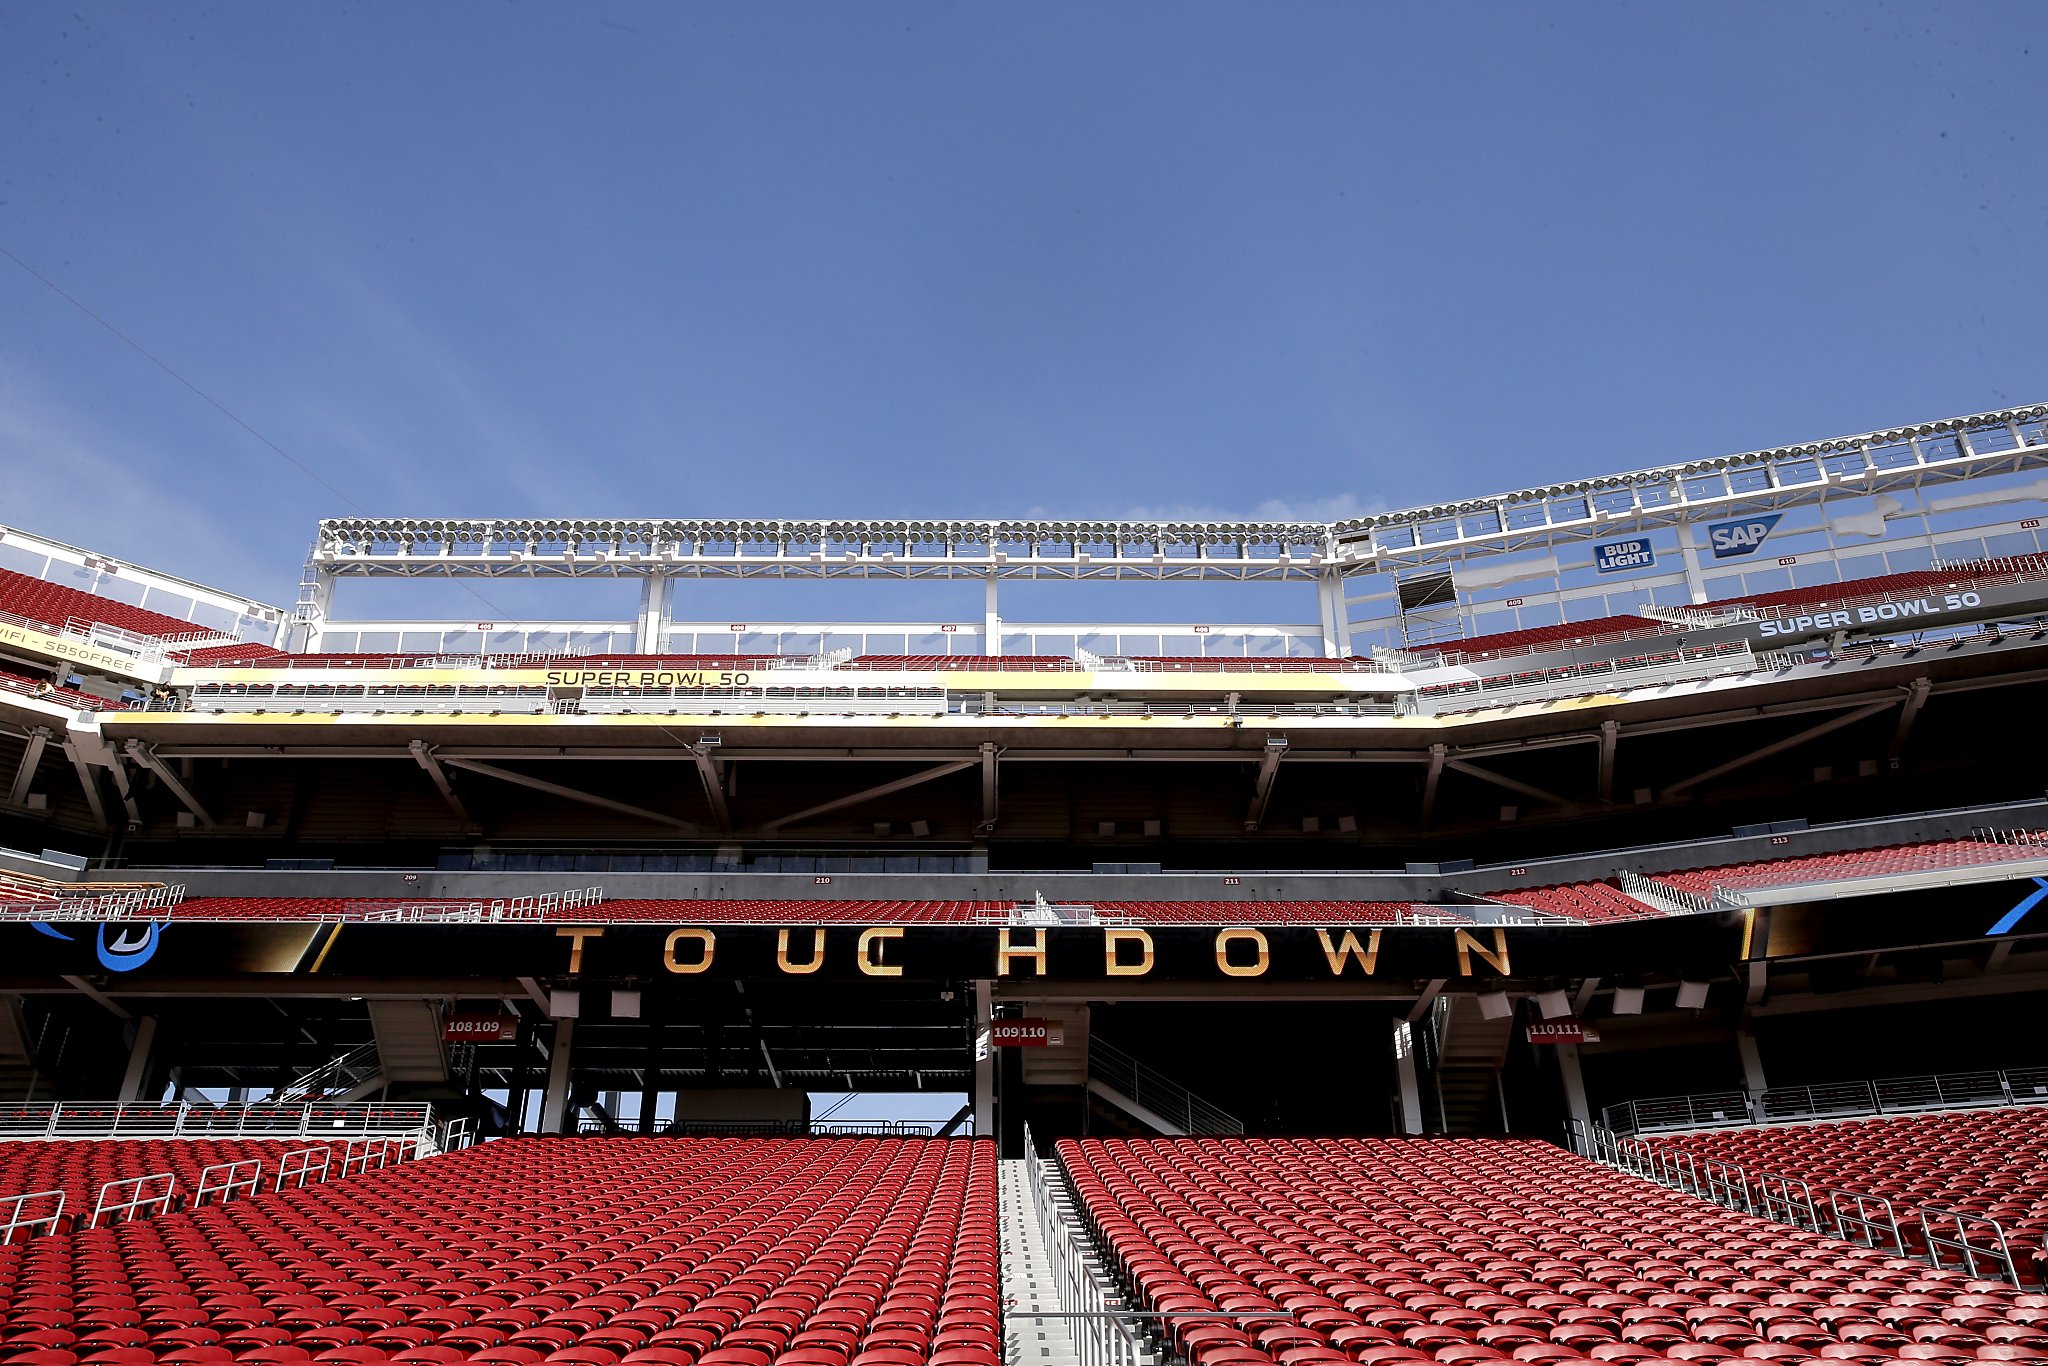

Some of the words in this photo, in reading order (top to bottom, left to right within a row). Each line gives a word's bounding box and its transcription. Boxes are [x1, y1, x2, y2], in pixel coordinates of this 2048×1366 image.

[2022, 520, 2038, 528] 411
[1712, 523, 1767, 550] SAP
[1604, 542, 1641, 557] BUD
[1599, 551, 1650, 569] LIGHT
[1758, 610, 1853, 637] SUPER
[1857, 598, 1940, 623] BOWL
[1944, 592, 1981, 610] 50
[547, 672, 631, 686] SUPER
[640, 672, 711, 686] BOWL
[720, 672, 750, 686] 50
[1511, 868, 1526, 876] 212
[448, 1021, 473, 1032] 108
[474, 1021, 500, 1032] 109
[994, 1027, 1019, 1038] 109
[1020, 1027, 1045, 1038] 110
[1530, 1024, 1555, 1035] 110
[1556, 1024, 1581, 1035] 111
